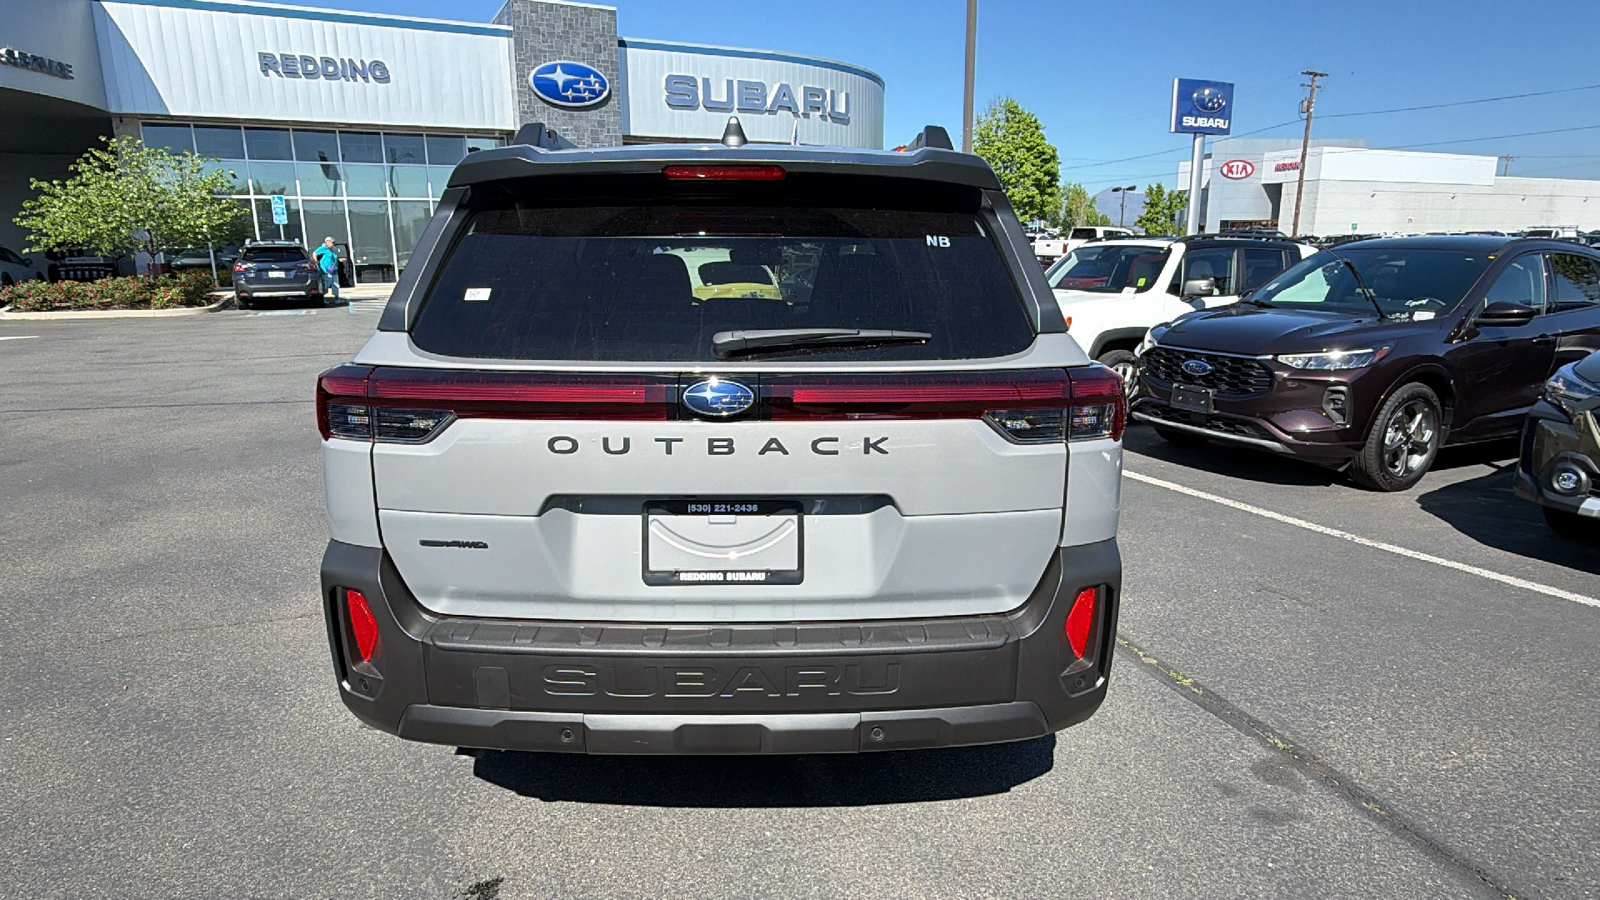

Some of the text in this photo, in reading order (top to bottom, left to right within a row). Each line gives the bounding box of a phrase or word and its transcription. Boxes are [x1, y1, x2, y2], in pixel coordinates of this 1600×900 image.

[258, 51, 391, 84] REDDING
[665, 74, 851, 126] SUBARU
[1182, 116, 1229, 129] SUBARU
[926, 234, 950, 248] NB
[547, 436, 890, 456] OUTBACK
[687, 504, 758, 513] (530) 221-2436
[679, 572, 766, 581] REDDING SUBARU
[542, 663, 901, 698] SUBARU
